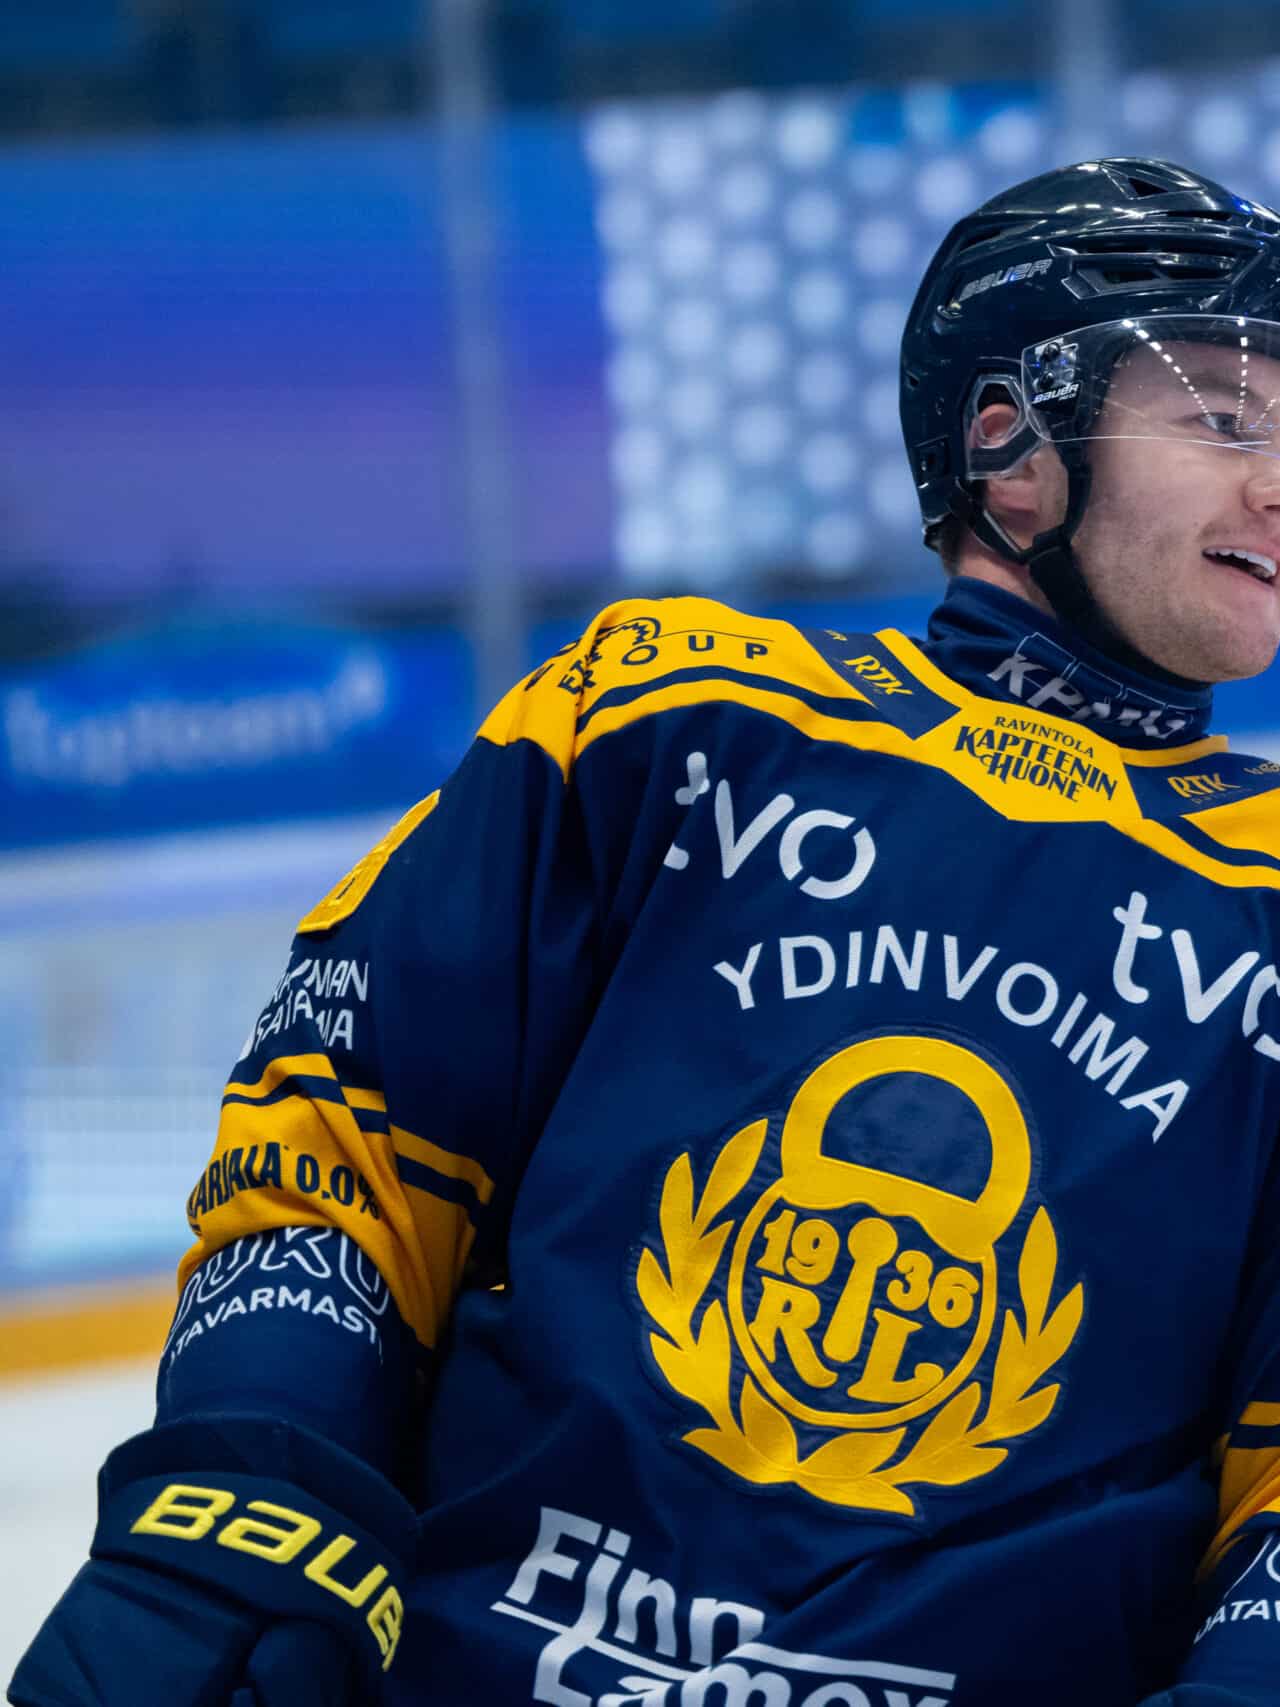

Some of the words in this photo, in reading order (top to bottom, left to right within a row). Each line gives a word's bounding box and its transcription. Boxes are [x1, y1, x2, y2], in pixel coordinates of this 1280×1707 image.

[953, 726, 1118, 801] KAPTEENIN
[994, 716, 1095, 759] RAVINTOLA
[980, 752, 1084, 803] HUONE
[1167, 772, 1242, 798] RTK
[712, 925, 1190, 1144] YDINVOIMA
[755, 1209, 841, 1285] 19
[886, 1250, 979, 1328] 36
[505, 1506, 765, 1666] Finn
